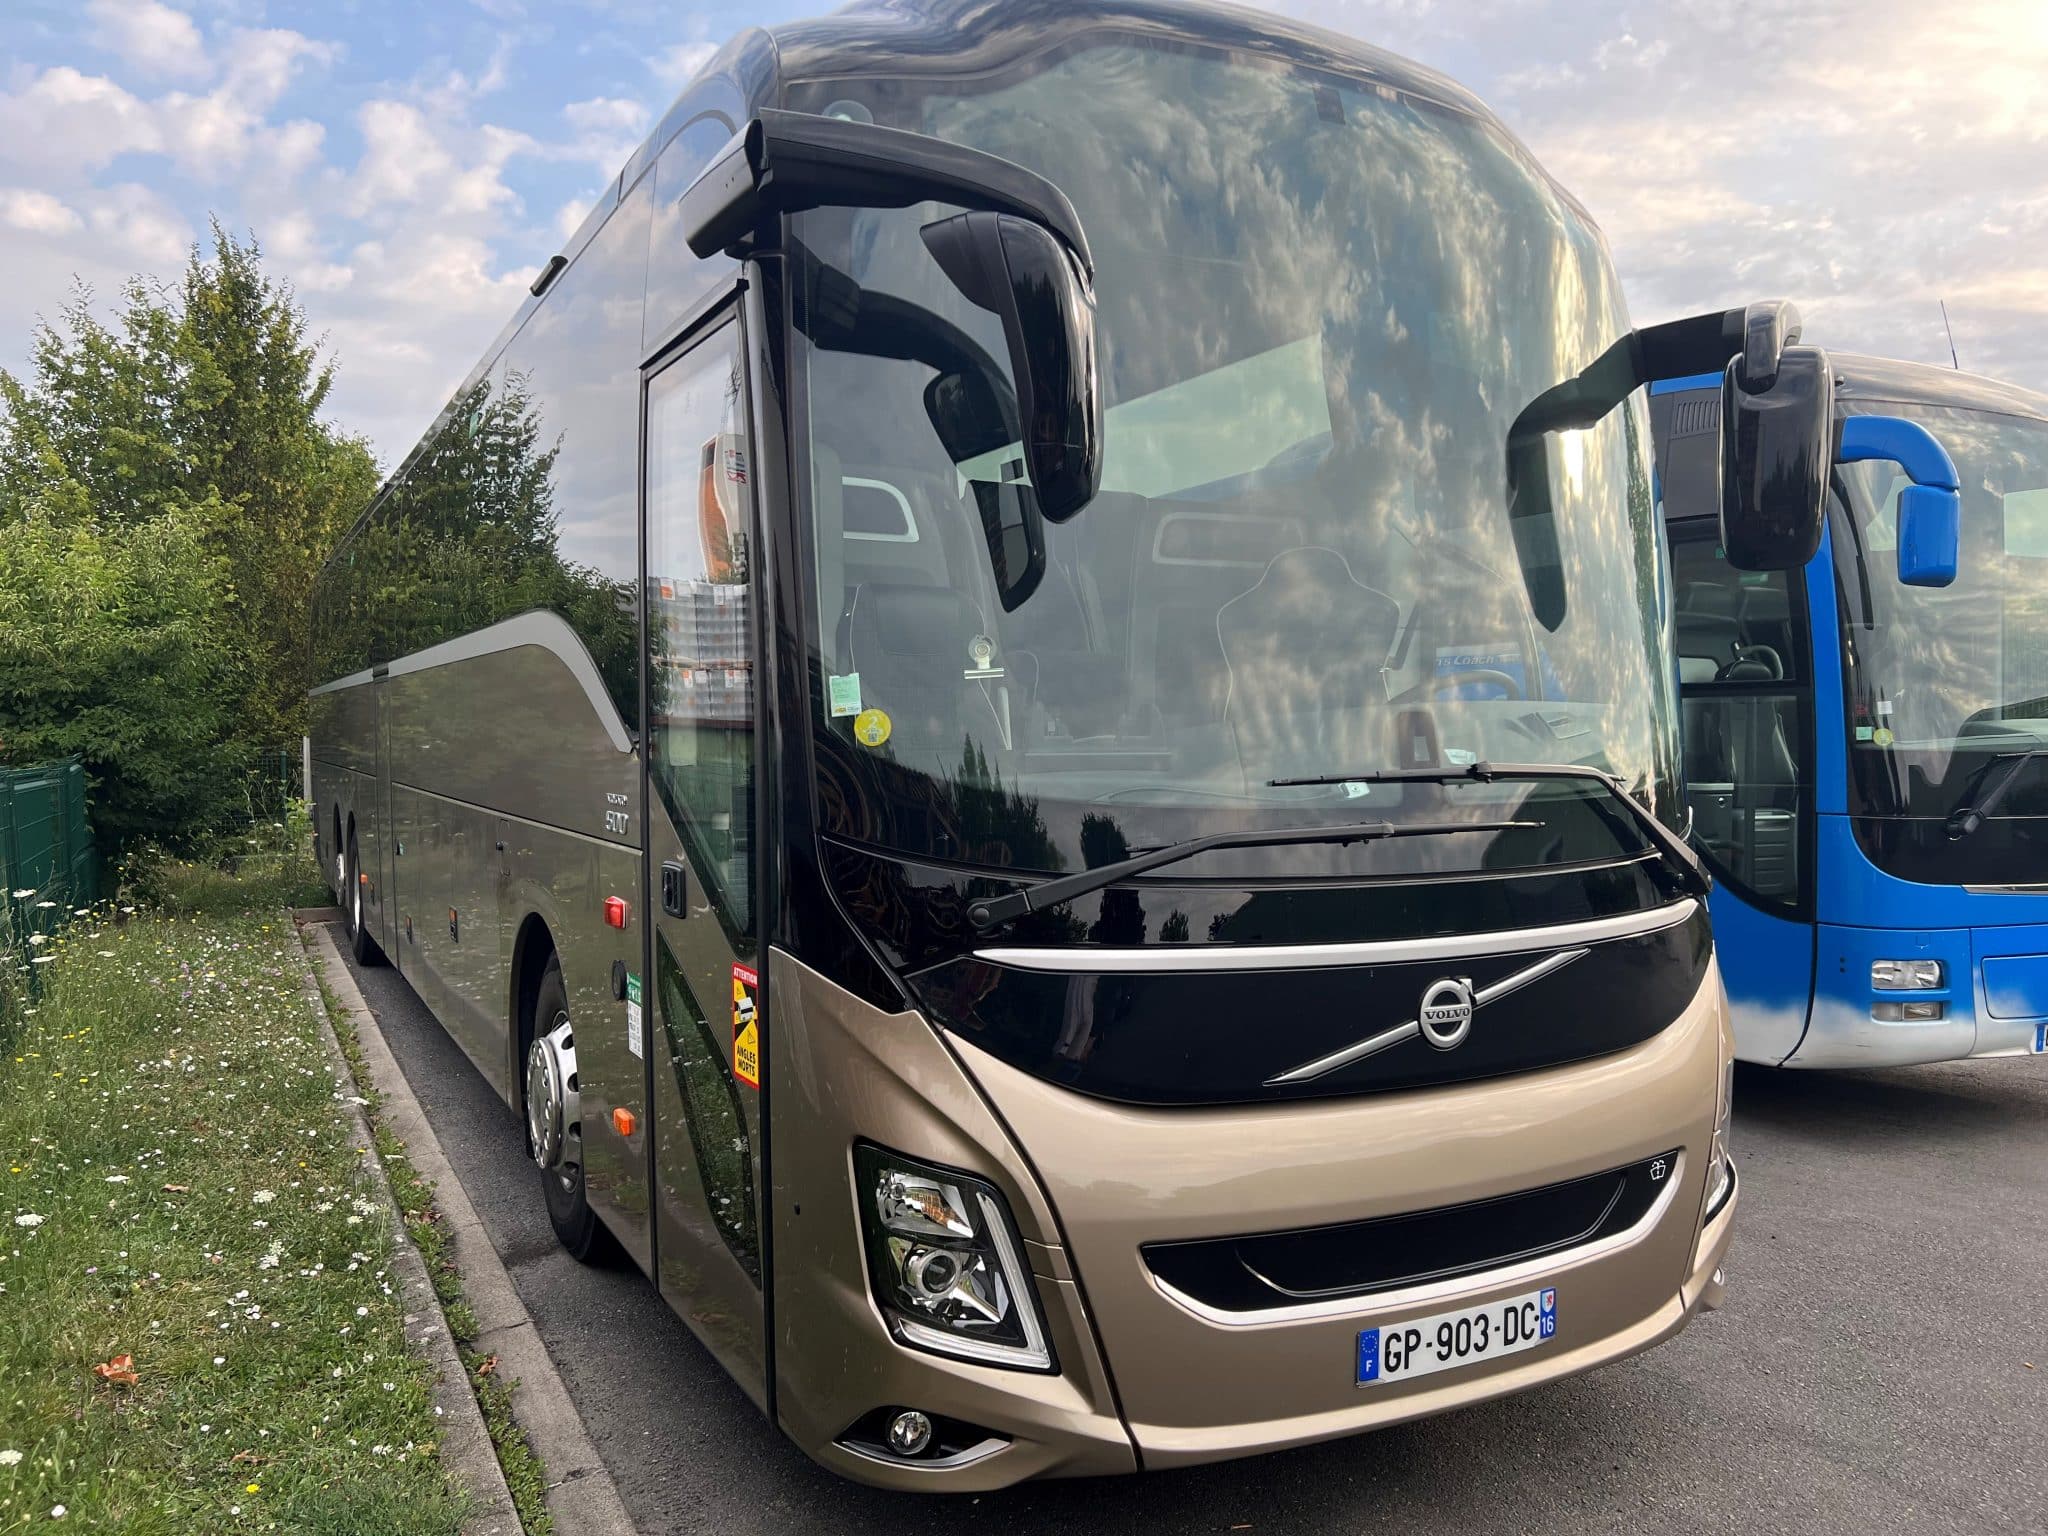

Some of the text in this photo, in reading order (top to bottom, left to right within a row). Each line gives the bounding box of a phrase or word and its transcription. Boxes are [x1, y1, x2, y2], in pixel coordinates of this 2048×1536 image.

[1424, 1007, 1470, 1020] VOLVO
[736, 1045, 756, 1064] ANGLES
[737, 1058, 756, 1077] MORTS
[1541, 1315, 1554, 1334] 16
[1384, 1301, 1536, 1373] GP-903-DC
[1365, 1359, 1373, 1373] F
